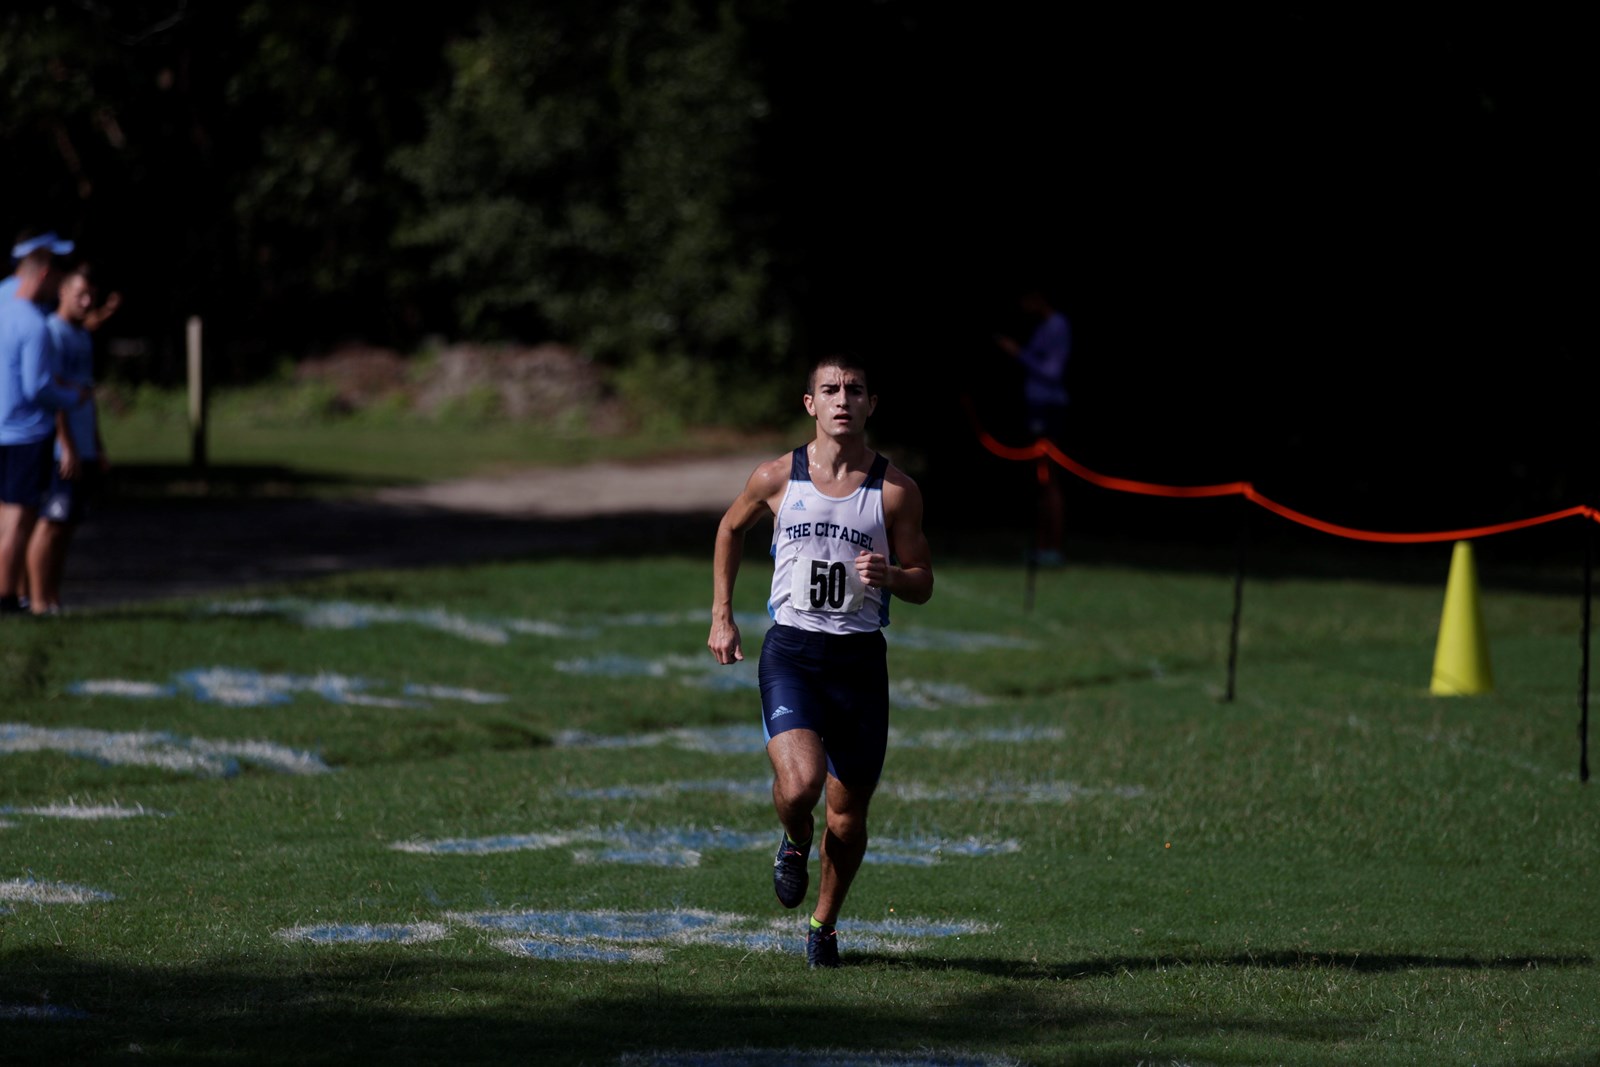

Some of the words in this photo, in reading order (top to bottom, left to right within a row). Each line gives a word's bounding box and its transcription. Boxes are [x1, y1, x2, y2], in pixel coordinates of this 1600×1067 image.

[786, 522, 811, 540] THE
[814, 522, 874, 551] CITADEL
[810, 560, 846, 609] 50
